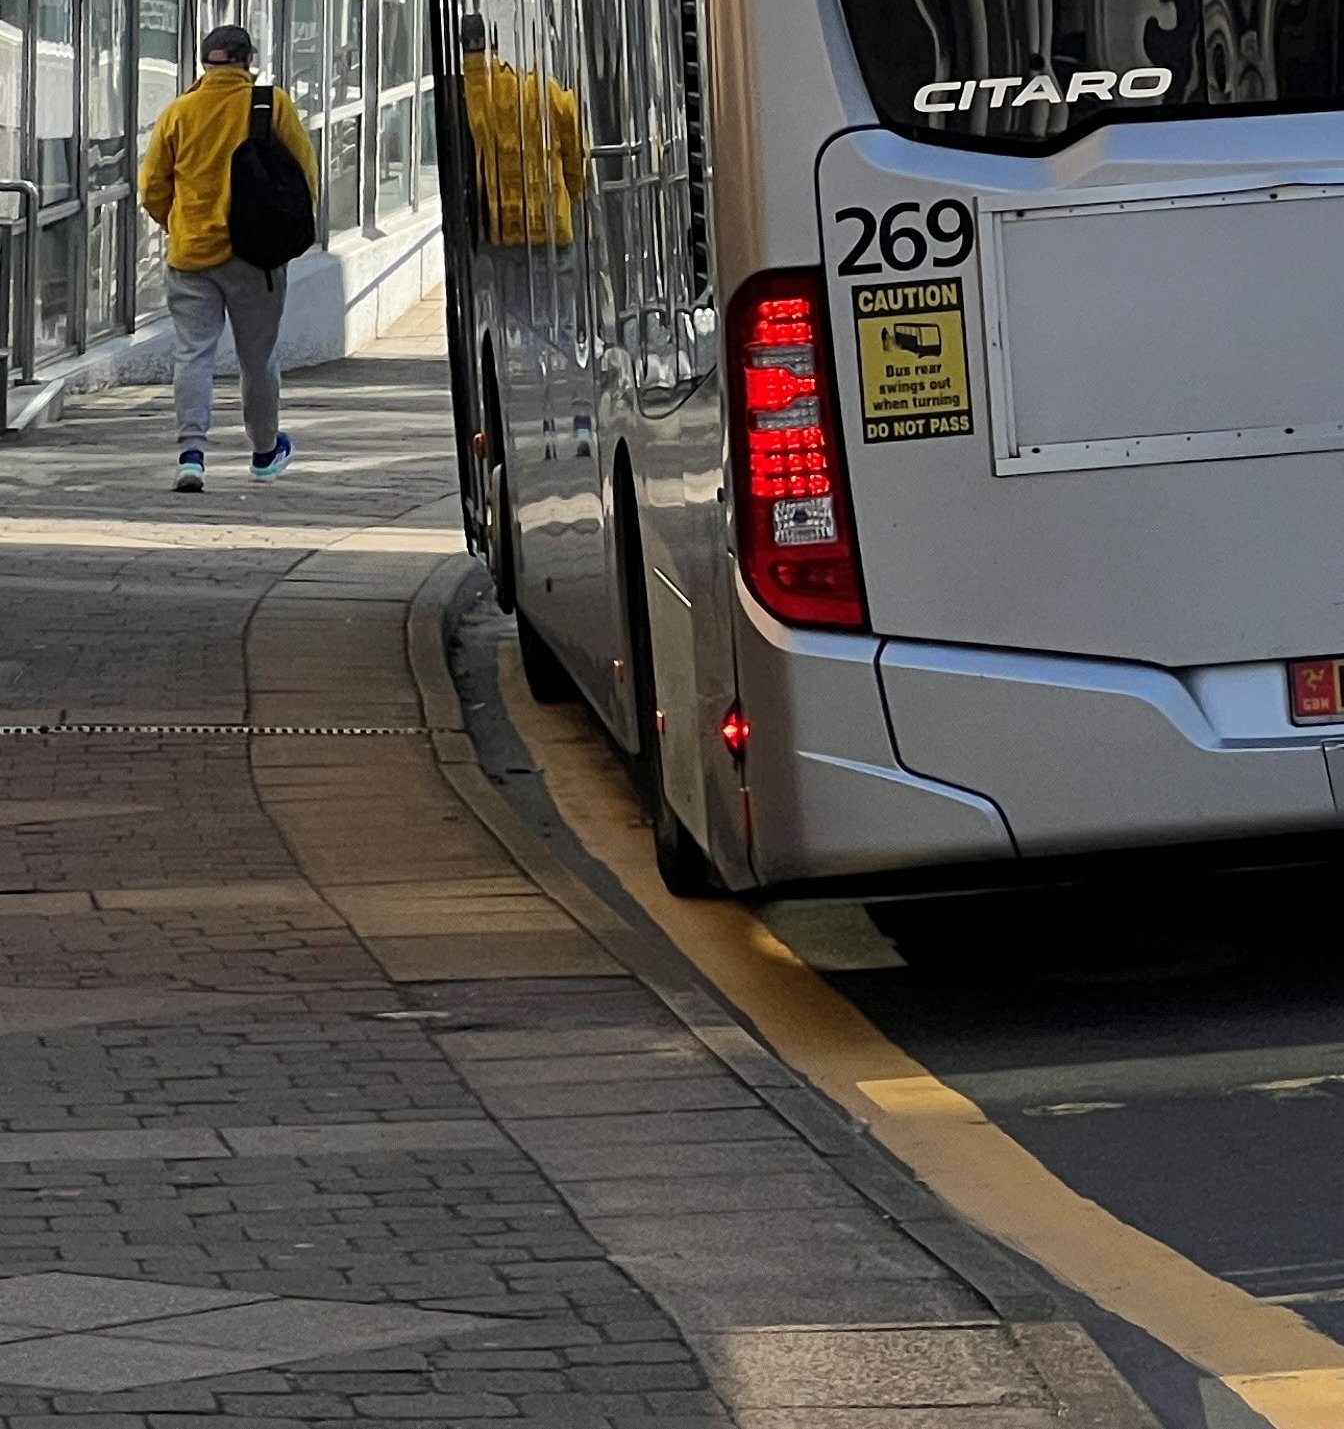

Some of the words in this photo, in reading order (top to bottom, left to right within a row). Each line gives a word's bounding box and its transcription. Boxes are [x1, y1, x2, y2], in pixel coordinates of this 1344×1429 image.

[913, 67, 1173, 113] CITARO
[835, 198, 975, 276] 269
[858, 283, 958, 313] CAUTION
[885, 363, 912, 378] Bus
[914, 362, 942, 375] rear
[879, 379, 926, 397] swings
[929, 376, 951, 390] out
[873, 396, 909, 411] when
[912, 392, 961, 409] turning
[866, 421, 890, 439] DO
[893, 419, 927, 437] NOT
[930, 415, 970, 434] PASS
